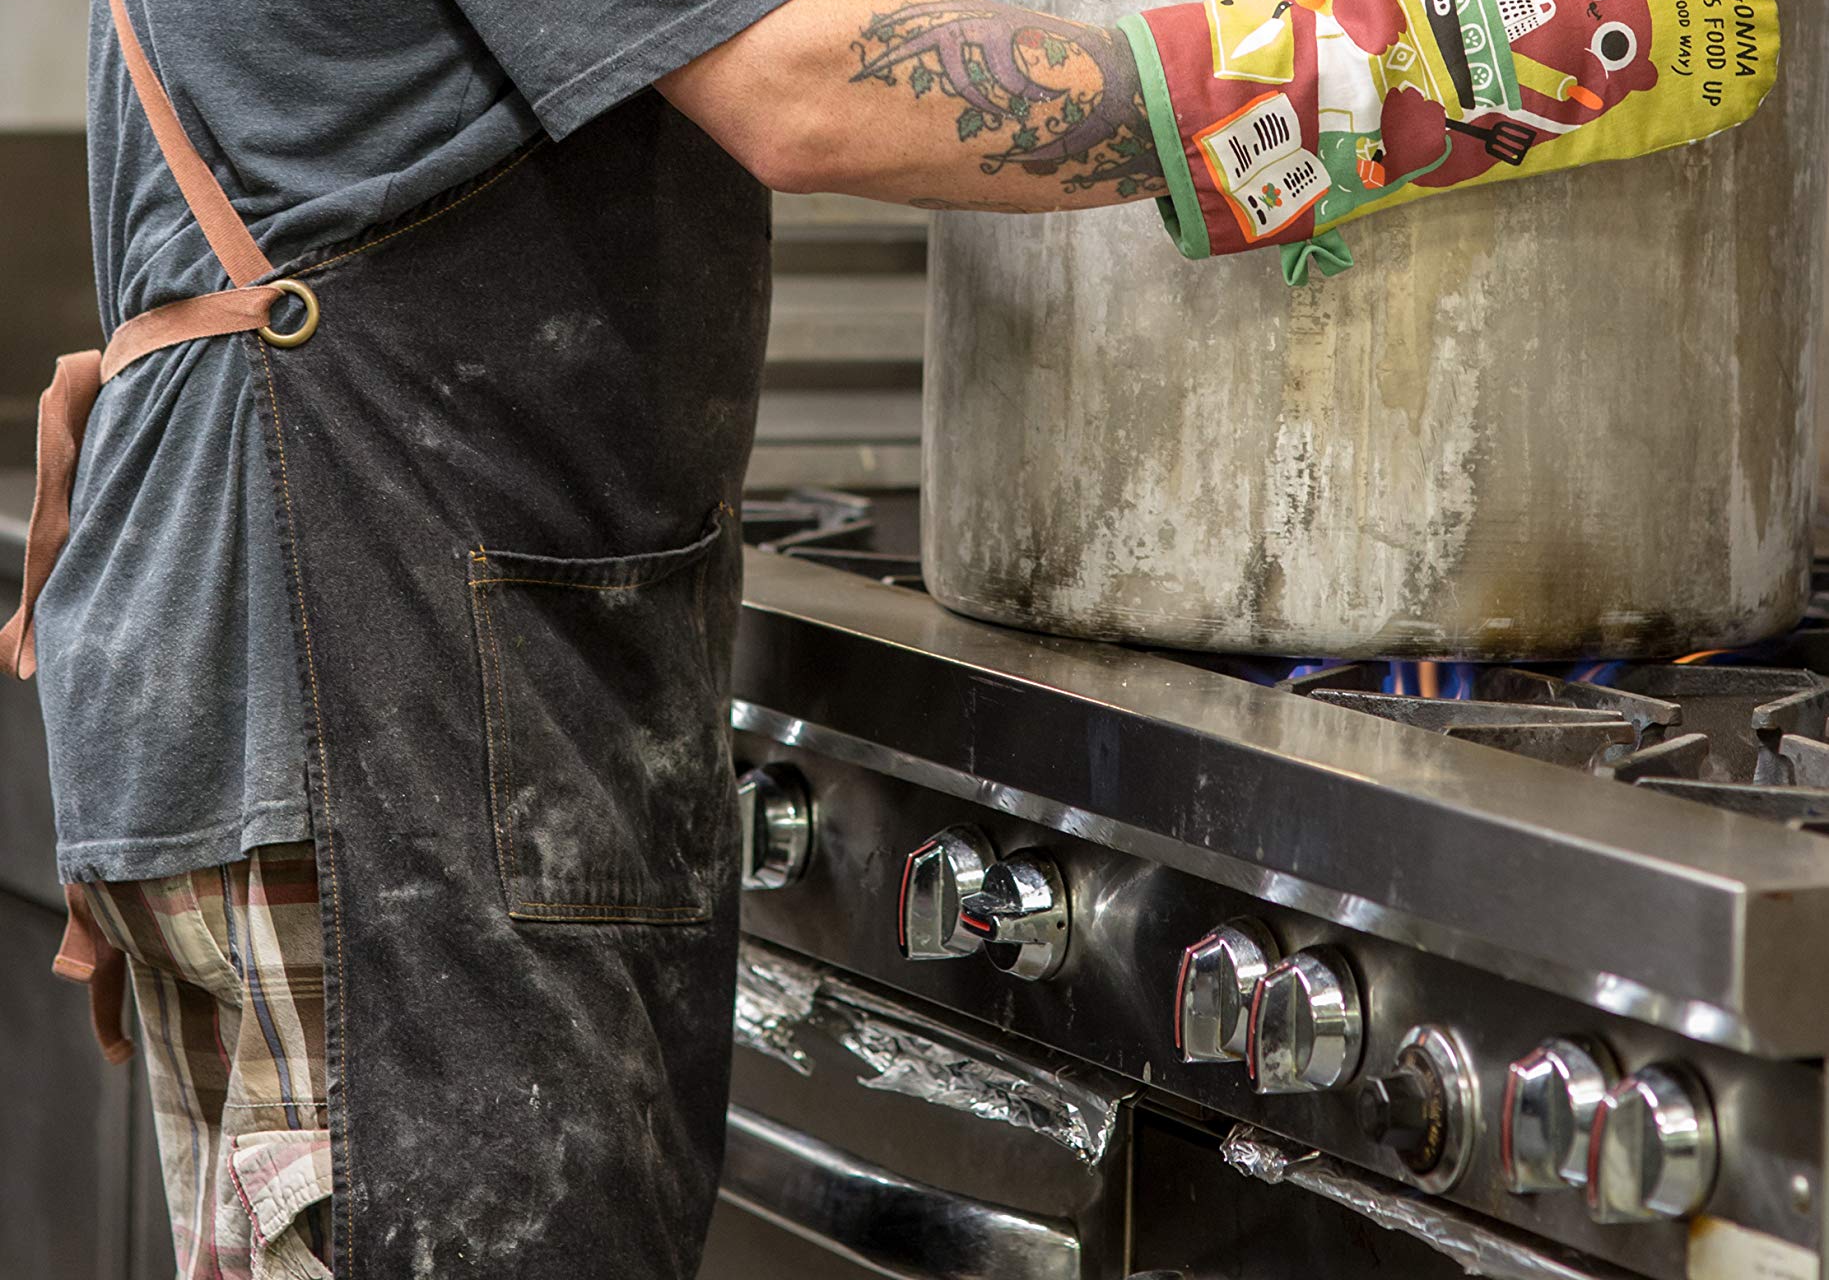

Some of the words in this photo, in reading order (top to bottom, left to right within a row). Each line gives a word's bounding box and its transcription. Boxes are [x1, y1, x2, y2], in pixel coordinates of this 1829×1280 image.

[1671, 34, 1693, 77] WAY)
[1704, 18, 1727, 70] FOOD
[1702, 81, 1723, 107] UP
